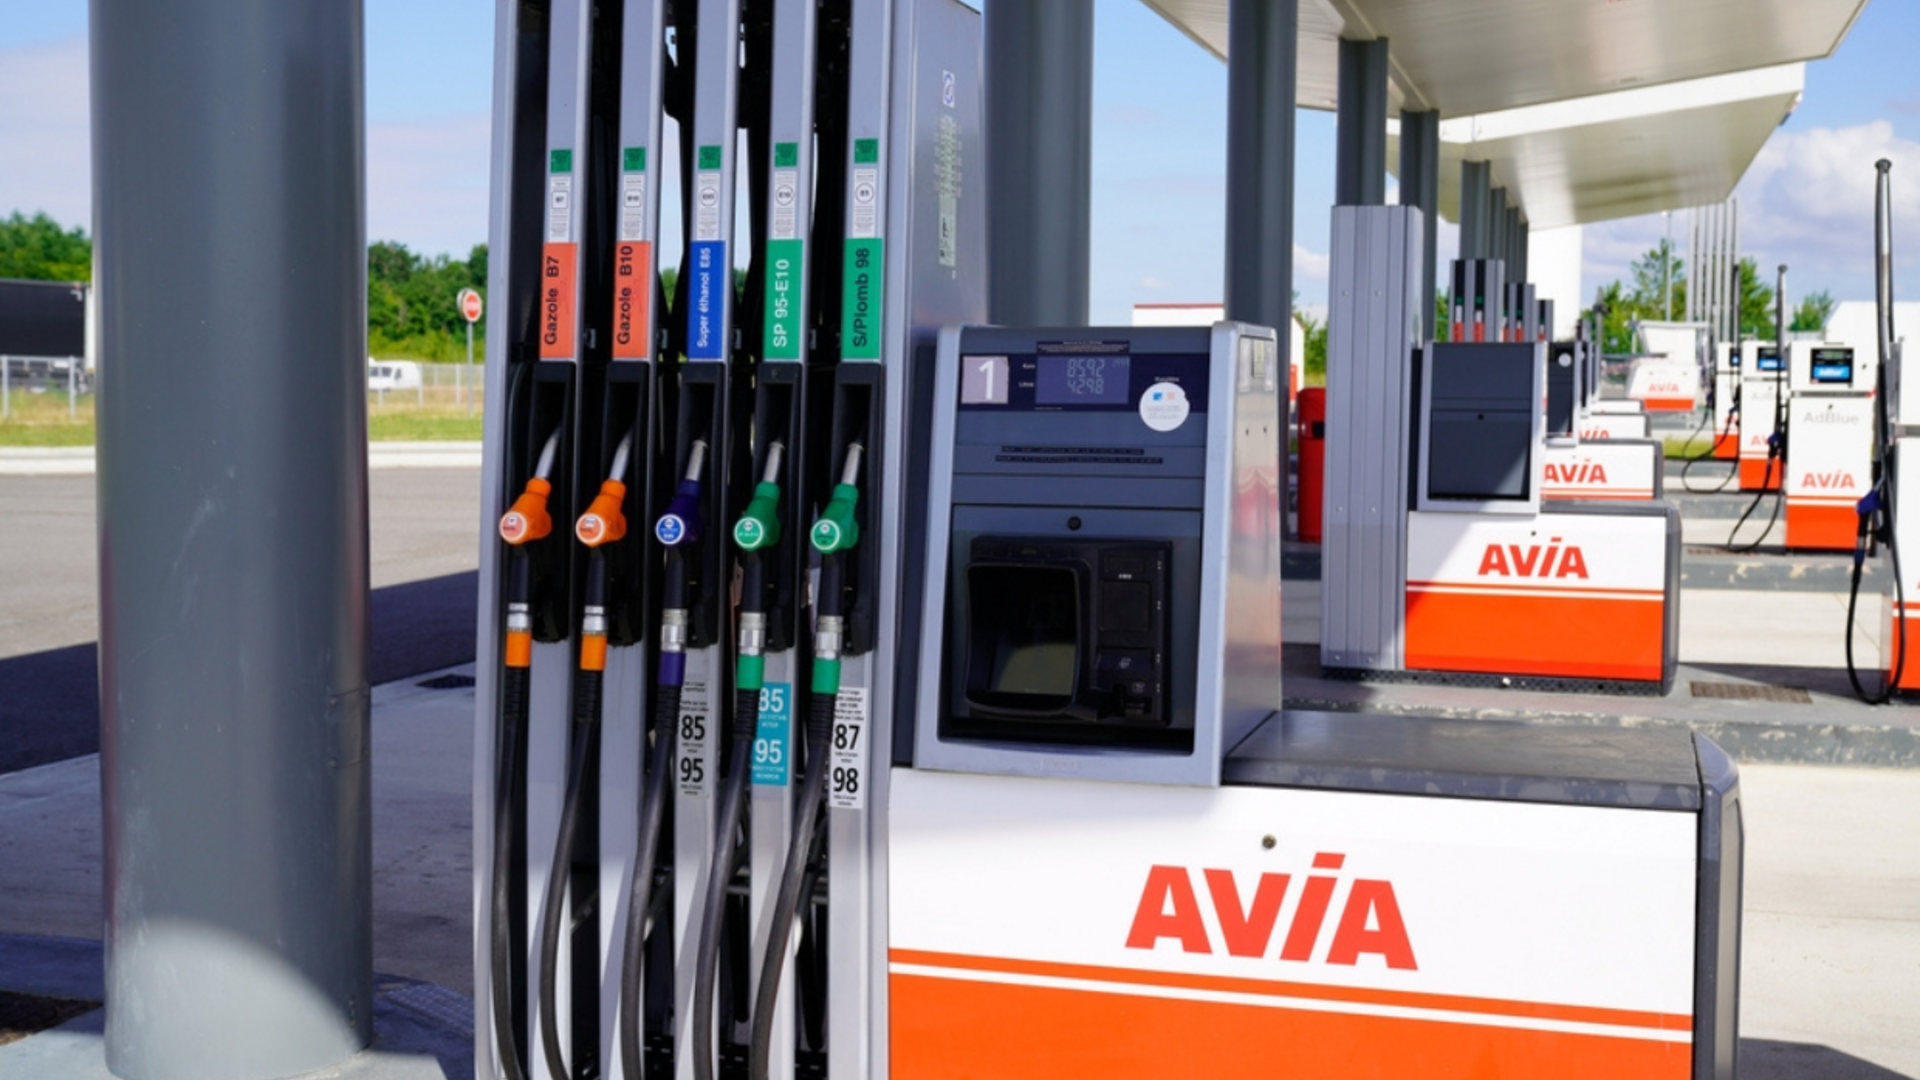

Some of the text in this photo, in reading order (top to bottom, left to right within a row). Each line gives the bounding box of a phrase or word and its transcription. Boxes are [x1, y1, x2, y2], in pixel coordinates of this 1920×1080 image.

[618, 245, 633, 277] B10
[699, 247, 711, 269] E85
[855, 247, 870, 269] 98
[544, 255, 560, 346] Gazole B7
[697, 272, 711, 314] éthanol
[773, 258, 790, 348] SP 95-E10
[616, 287, 632, 346] Gazole
[852, 272, 869, 348] S/Plomb
[697, 316, 711, 348] Super
[979, 360, 995, 401] 1
[1803, 411, 1860, 425] AdBlue
[758, 687, 784, 713] 85
[681, 714, 706, 741] 85
[834, 723, 861, 751] 87
[754, 738, 782, 765] 95
[680, 757, 704, 784] 95
[832, 766, 859, 794] 98
